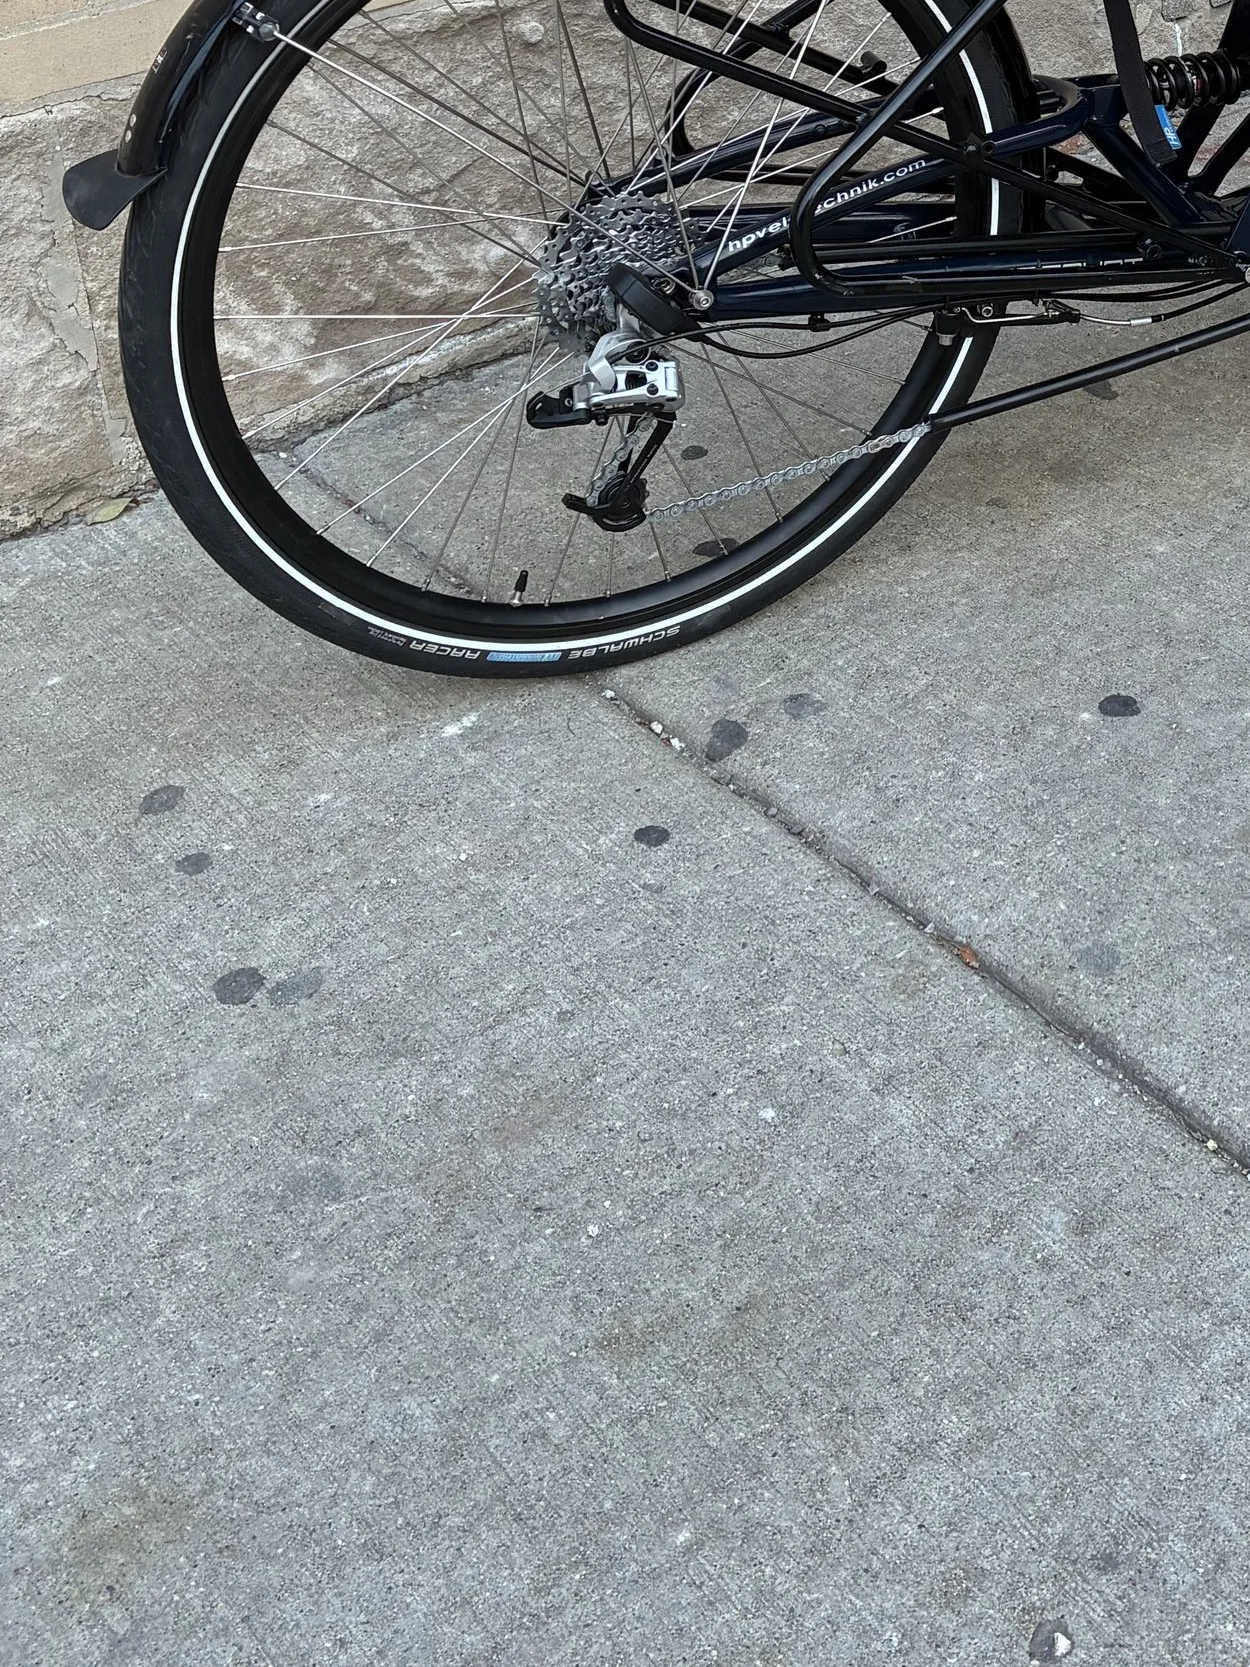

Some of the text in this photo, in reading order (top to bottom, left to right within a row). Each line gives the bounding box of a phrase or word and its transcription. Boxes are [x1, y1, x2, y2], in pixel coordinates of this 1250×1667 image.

[727, 158, 927, 253] hpvelchnik.com
[409, 640, 480, 659] RACER
[567, 625, 680, 659] SCHWALBE
